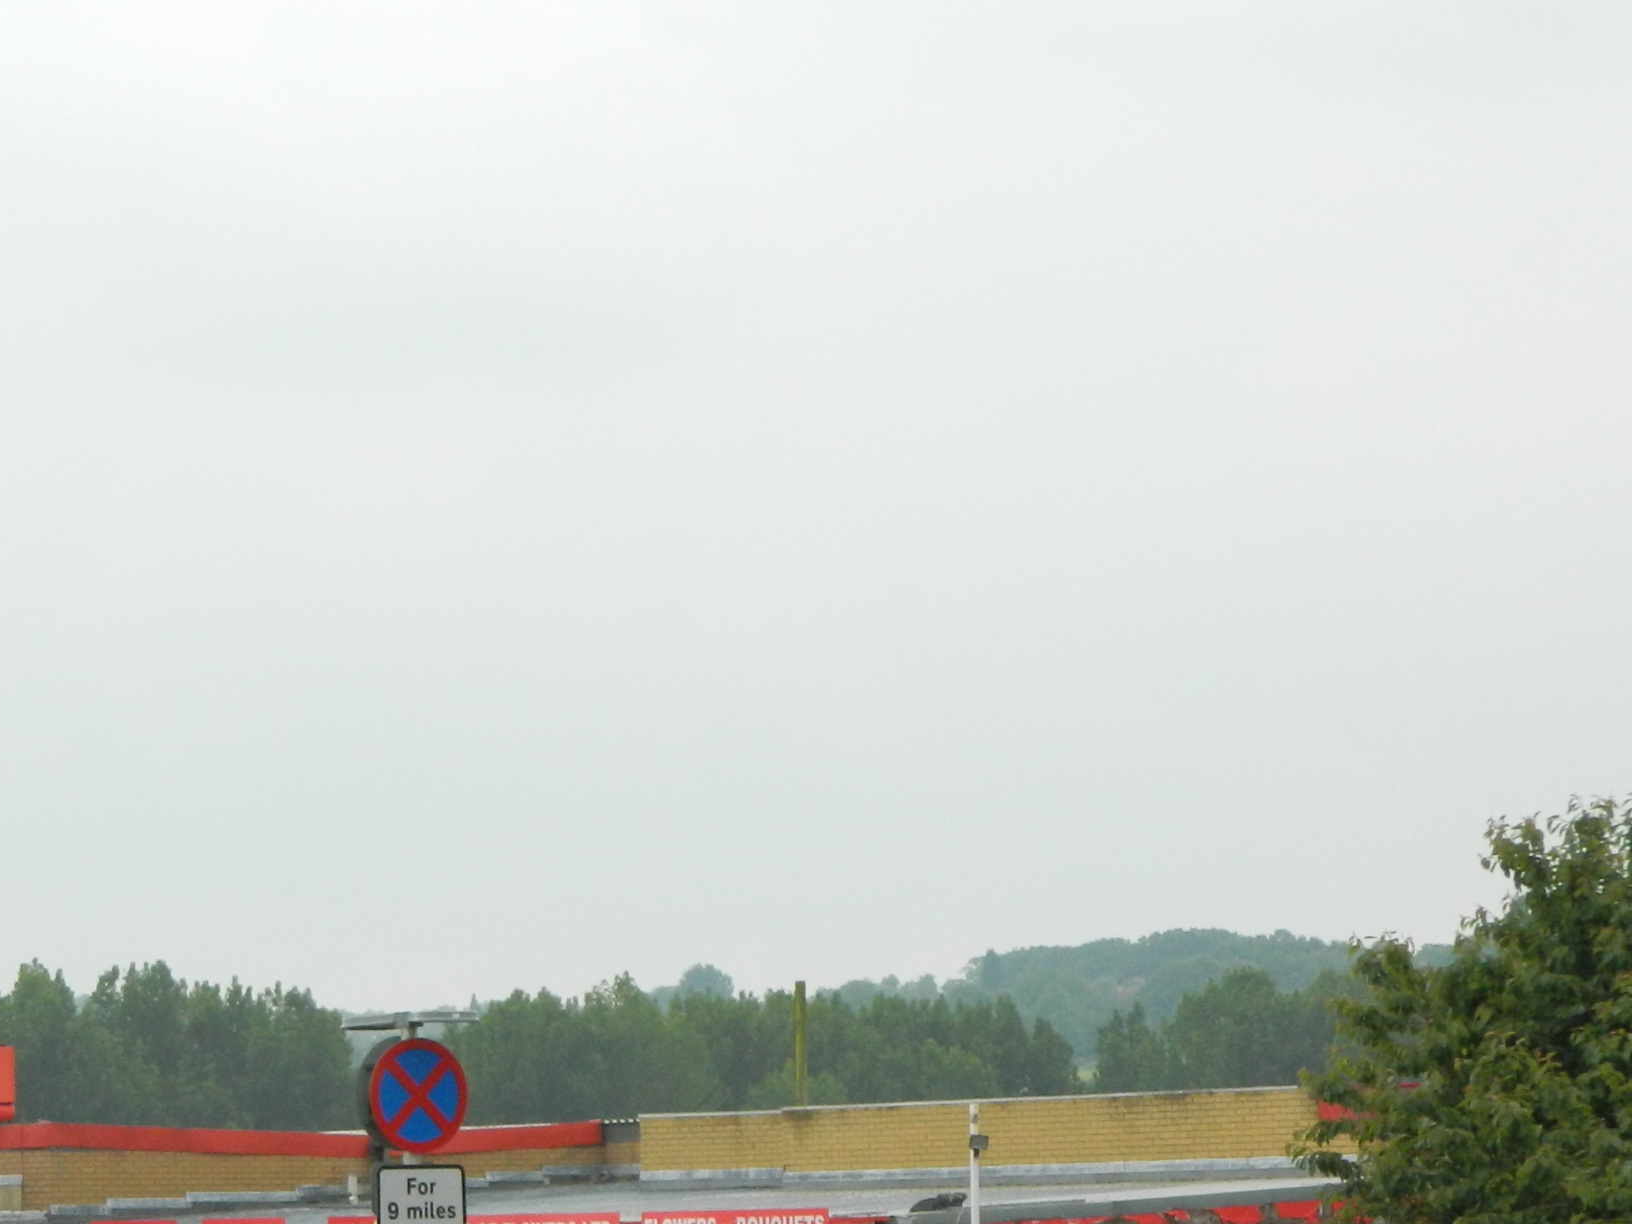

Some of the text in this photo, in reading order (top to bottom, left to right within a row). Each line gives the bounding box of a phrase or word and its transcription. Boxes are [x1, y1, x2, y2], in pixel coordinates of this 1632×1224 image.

[406, 1177, 436, 1195] For
[388, 1202, 456, 1220] 9 miles
